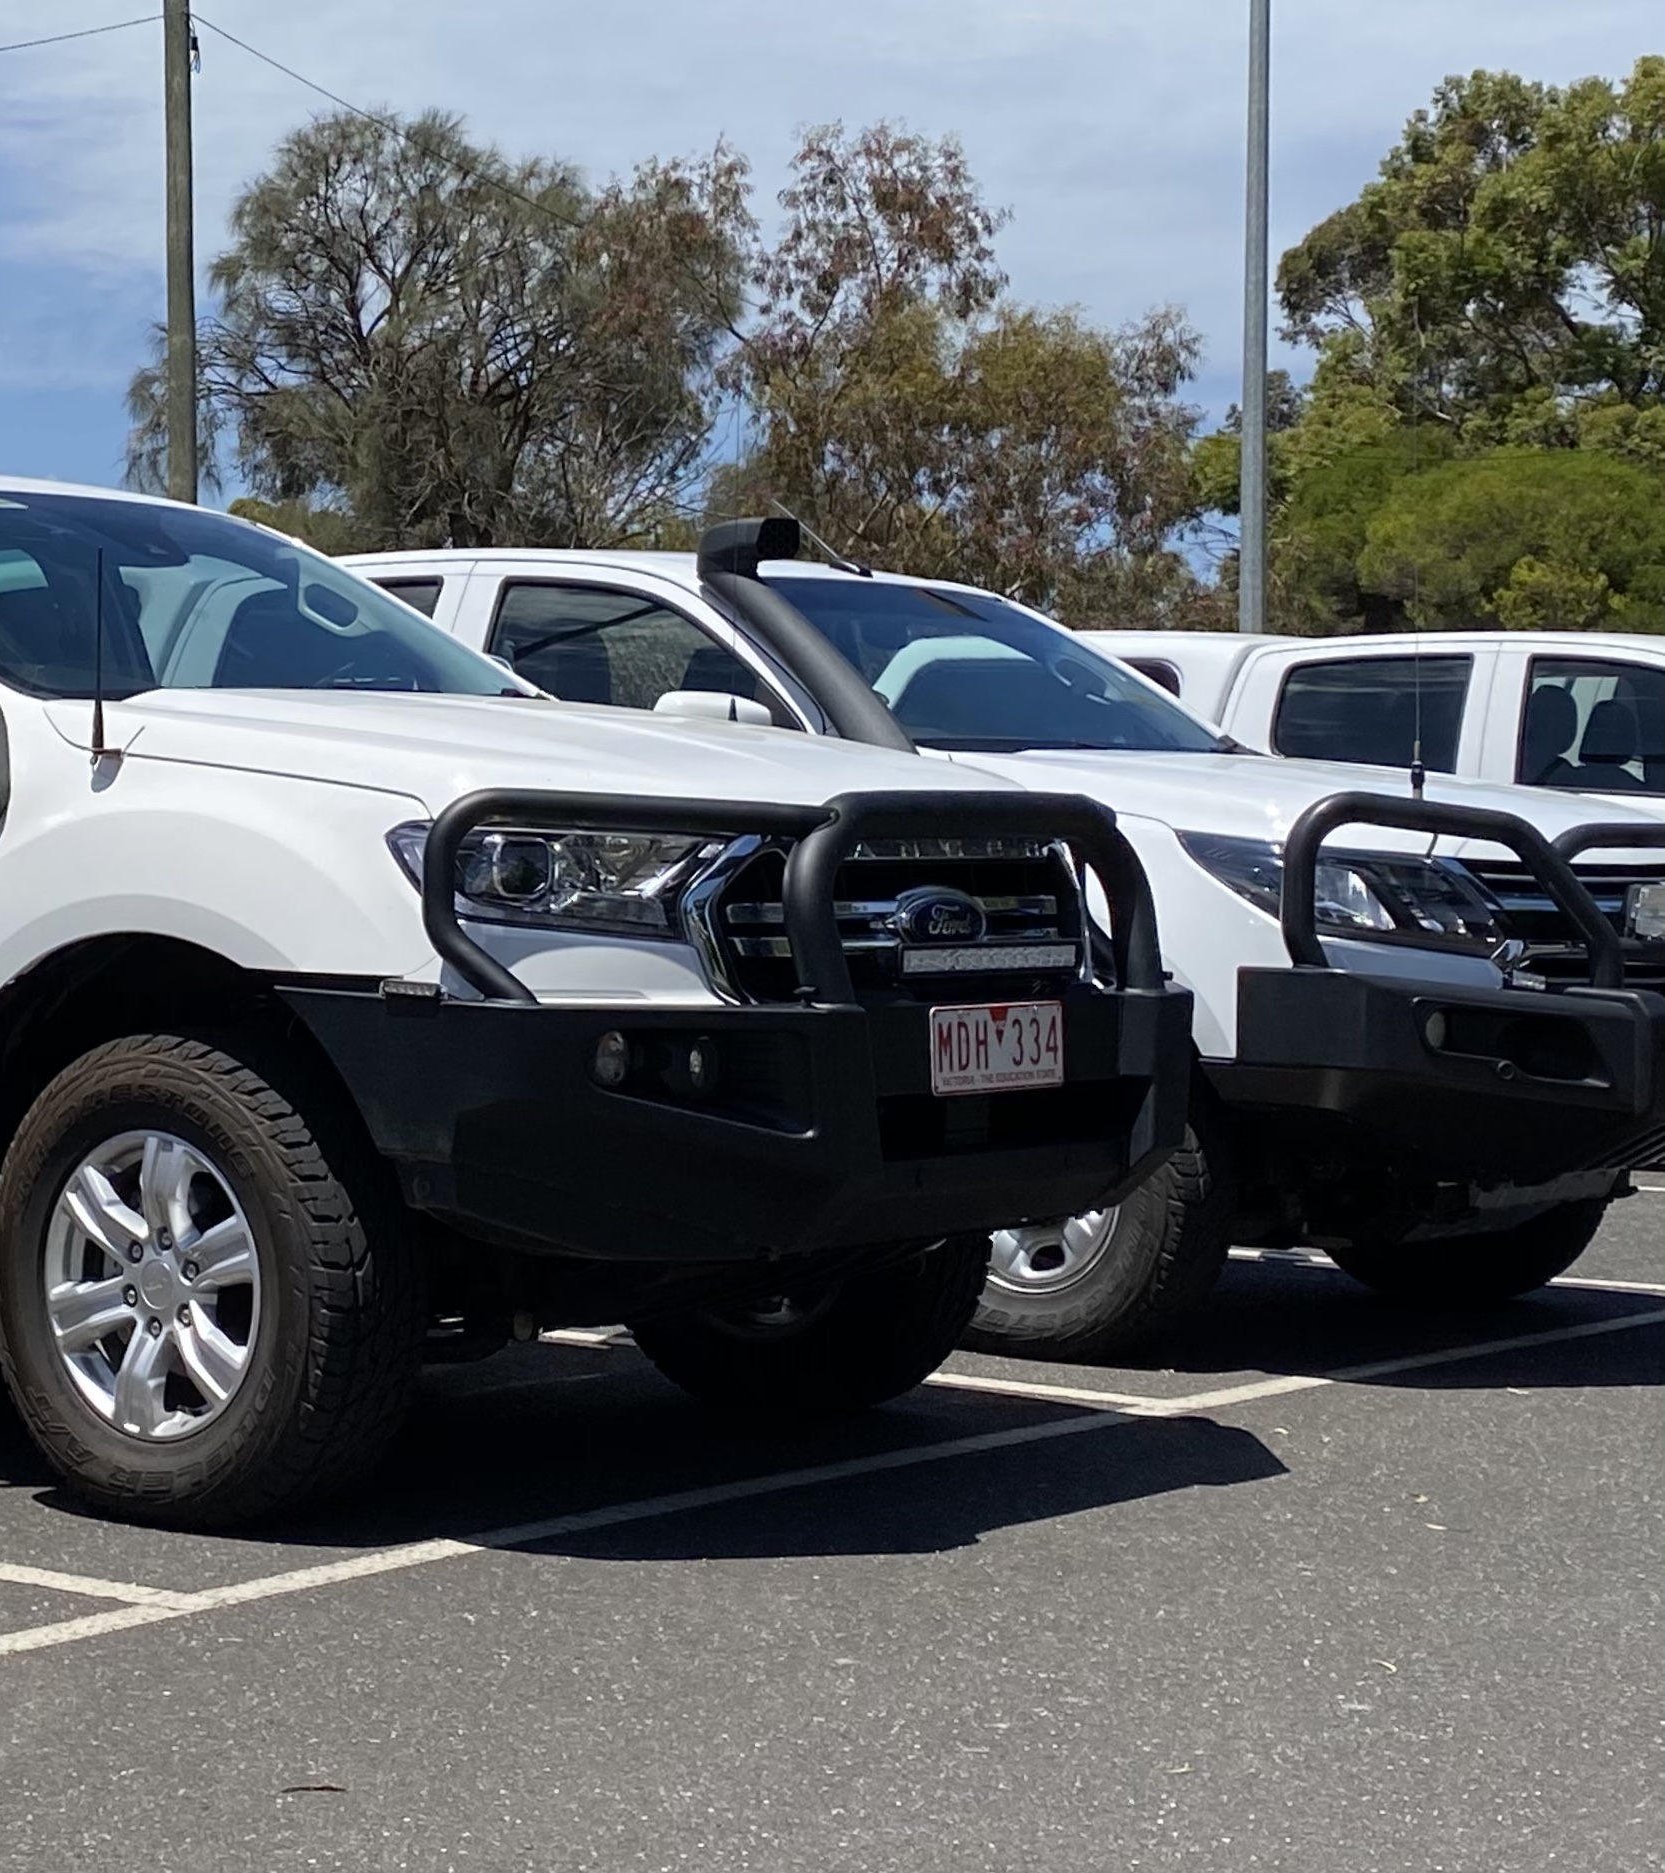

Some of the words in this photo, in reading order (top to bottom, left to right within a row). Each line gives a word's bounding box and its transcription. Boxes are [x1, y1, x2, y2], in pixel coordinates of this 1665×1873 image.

[928, 904, 972, 935] Ford
[938, 1019, 989, 1073] MDH
[1012, 1015, 1059, 1067] 334
